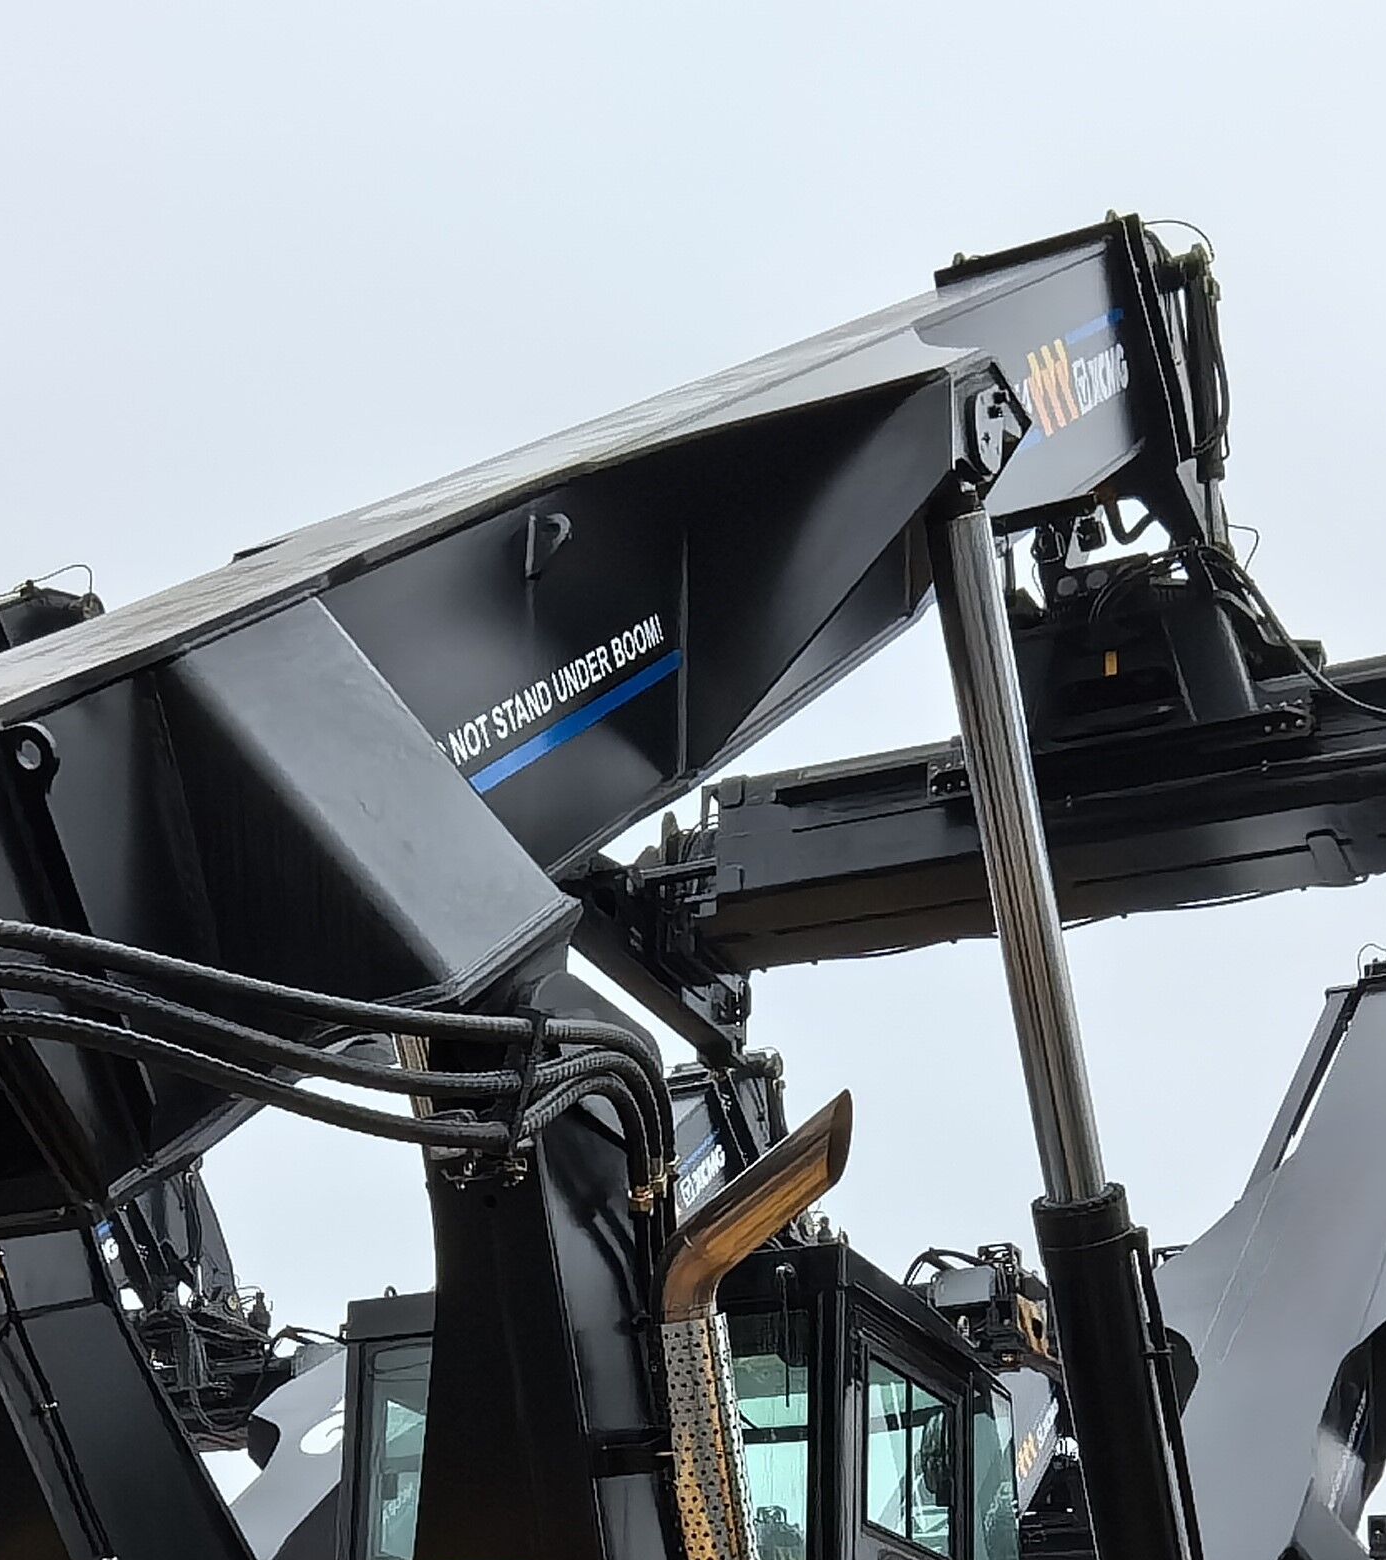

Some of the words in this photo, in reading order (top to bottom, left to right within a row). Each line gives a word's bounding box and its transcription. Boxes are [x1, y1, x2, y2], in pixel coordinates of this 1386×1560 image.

[448, 714, 491, 767] NOT
[492, 680, 553, 740] STAND
[551, 646, 613, 702] UNDER
[610, 613, 665, 669] BOOM!
